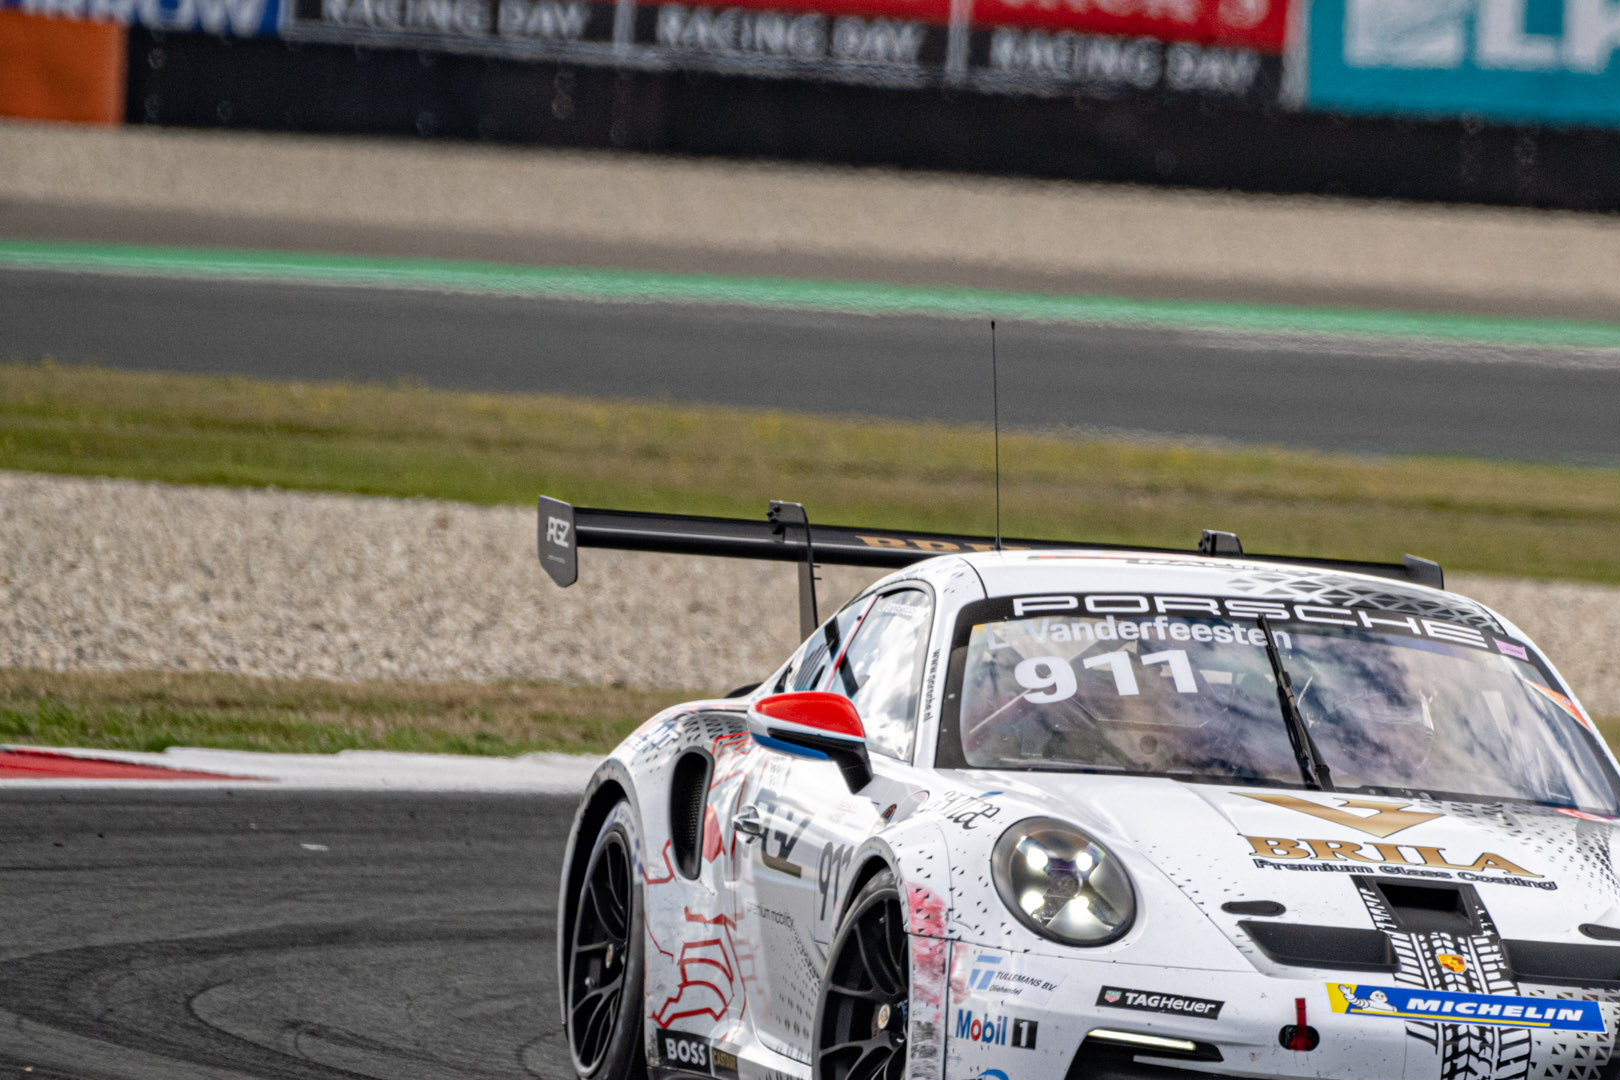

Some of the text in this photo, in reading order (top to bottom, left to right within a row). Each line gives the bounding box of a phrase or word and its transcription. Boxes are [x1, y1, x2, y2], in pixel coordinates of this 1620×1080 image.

[322, 0, 590, 42] RACING DAY
[657, 3, 925, 63] RACING DAY
[992, 26, 1259, 92] RACING DAY
[984, 615, 1293, 650] L. Vanderfeesten
[1012, 594, 1489, 650] PORSCHE
[1014, 650, 1198, 704] 911
[1245, 836, 1545, 878] BRILA
[1253, 859, 1558, 891] Premium Glass Coating
[955, 1009, 1008, 1046] Mobil
[1406, 998, 1583, 1021] MICHELIN
[665, 1037, 706, 1067] BOSS
